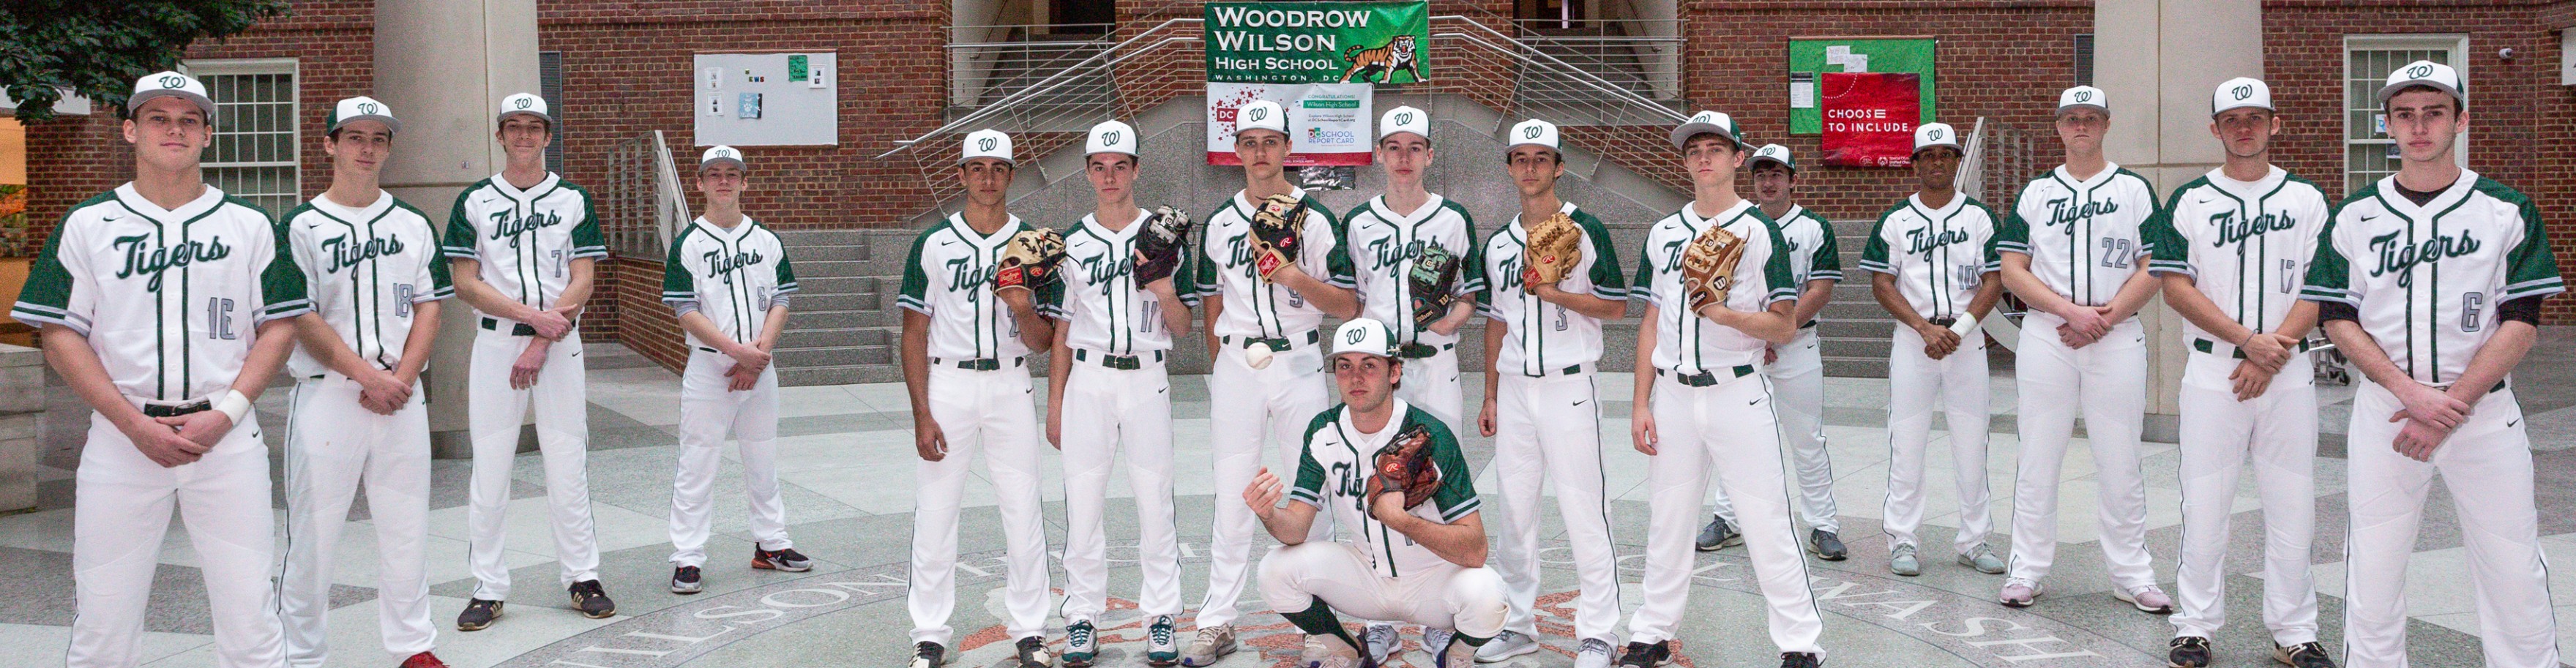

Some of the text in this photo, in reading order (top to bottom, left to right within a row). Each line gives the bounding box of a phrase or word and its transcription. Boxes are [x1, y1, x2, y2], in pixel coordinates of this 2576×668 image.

[1214, 7, 1371, 28] WOODROW
[1214, 31, 1336, 51] WILSON
[1215, 57, 1338, 70] HIGH SCHOOL
[2406, 64, 2433, 80] W
[159, 75, 186, 89] W
[2074, 90, 2091, 102] W
[2232, 84, 2252, 101] W
[357, 102, 378, 116] W
[515, 97, 533, 110] W
[1220, 110, 1233, 119] DC
[1249, 107, 1267, 121] W
[1395, 111, 1413, 126] W
[1828, 109, 1886, 119] CHOOSE
[1524, 125, 1543, 140] W
[1829, 123, 1912, 132] TO INCLUDE.
[1927, 128, 1944, 141] W
[978, 137, 998, 152] W
[1101, 130, 1120, 146] W
[2045, 197, 2118, 236] Tigers
[489, 207, 561, 249] Tigers
[2209, 209, 2296, 256] Tigers
[1905, 225, 1969, 263] Tigers
[2101, 237, 2130, 269] 22
[113, 232, 231, 293] Tigers
[321, 233, 404, 281] Tigers
[551, 249, 562, 278] 7
[703, 248, 764, 285] Tigers
[2369, 229, 2481, 288] Tigers
[1957, 265, 1976, 290] 10
[2280, 258, 2296, 294] 17
[393, 282, 414, 318] 18
[757, 286, 767, 312] 8
[207, 296, 236, 340] 16
[1140, 301, 1157, 333] 11
[2461, 292, 2483, 332] 6
[1346, 326, 1367, 345] W
